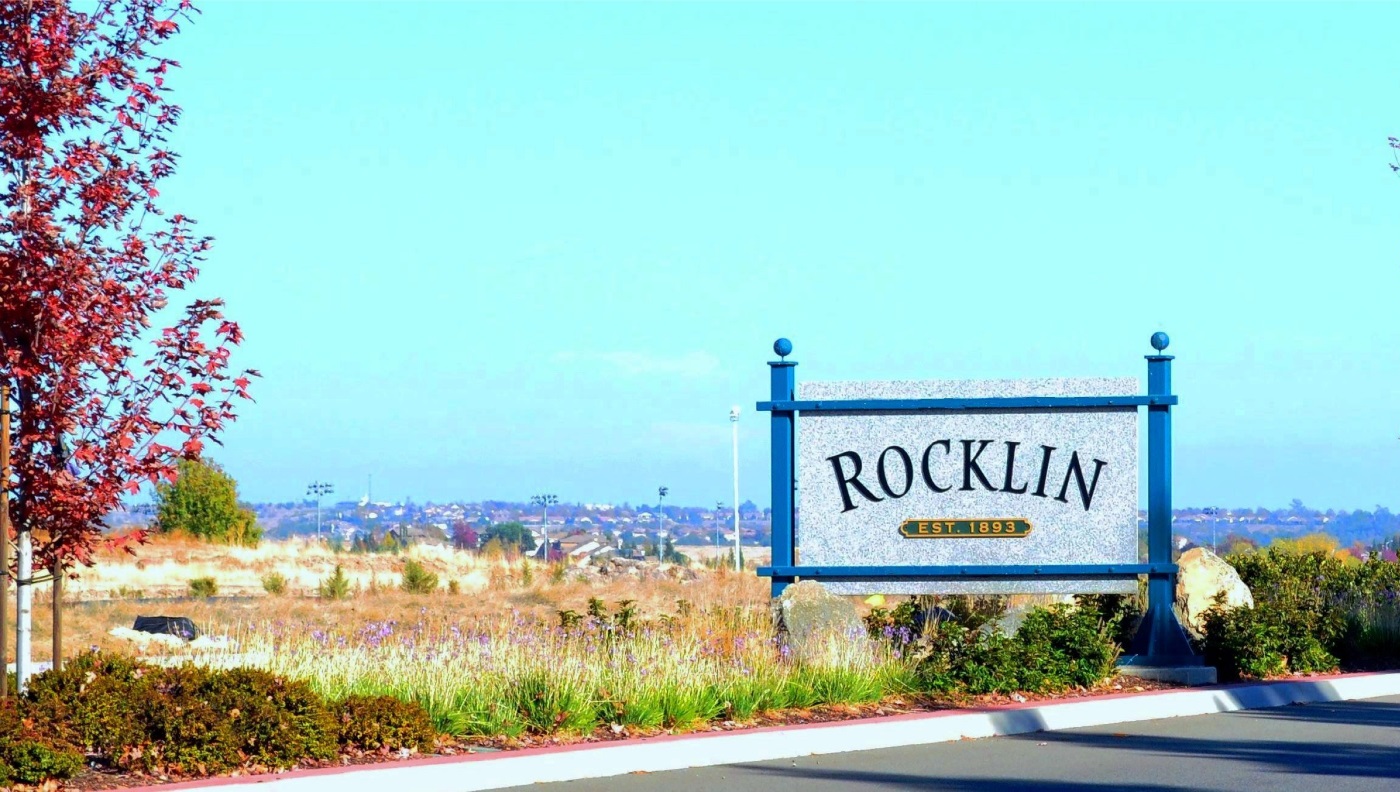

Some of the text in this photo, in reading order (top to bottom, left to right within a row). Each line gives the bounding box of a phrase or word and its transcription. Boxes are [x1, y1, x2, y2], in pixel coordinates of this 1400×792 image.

[825, 438, 1108, 513] ROCKLIN
[917, 521, 1016, 534] EST. 1893
